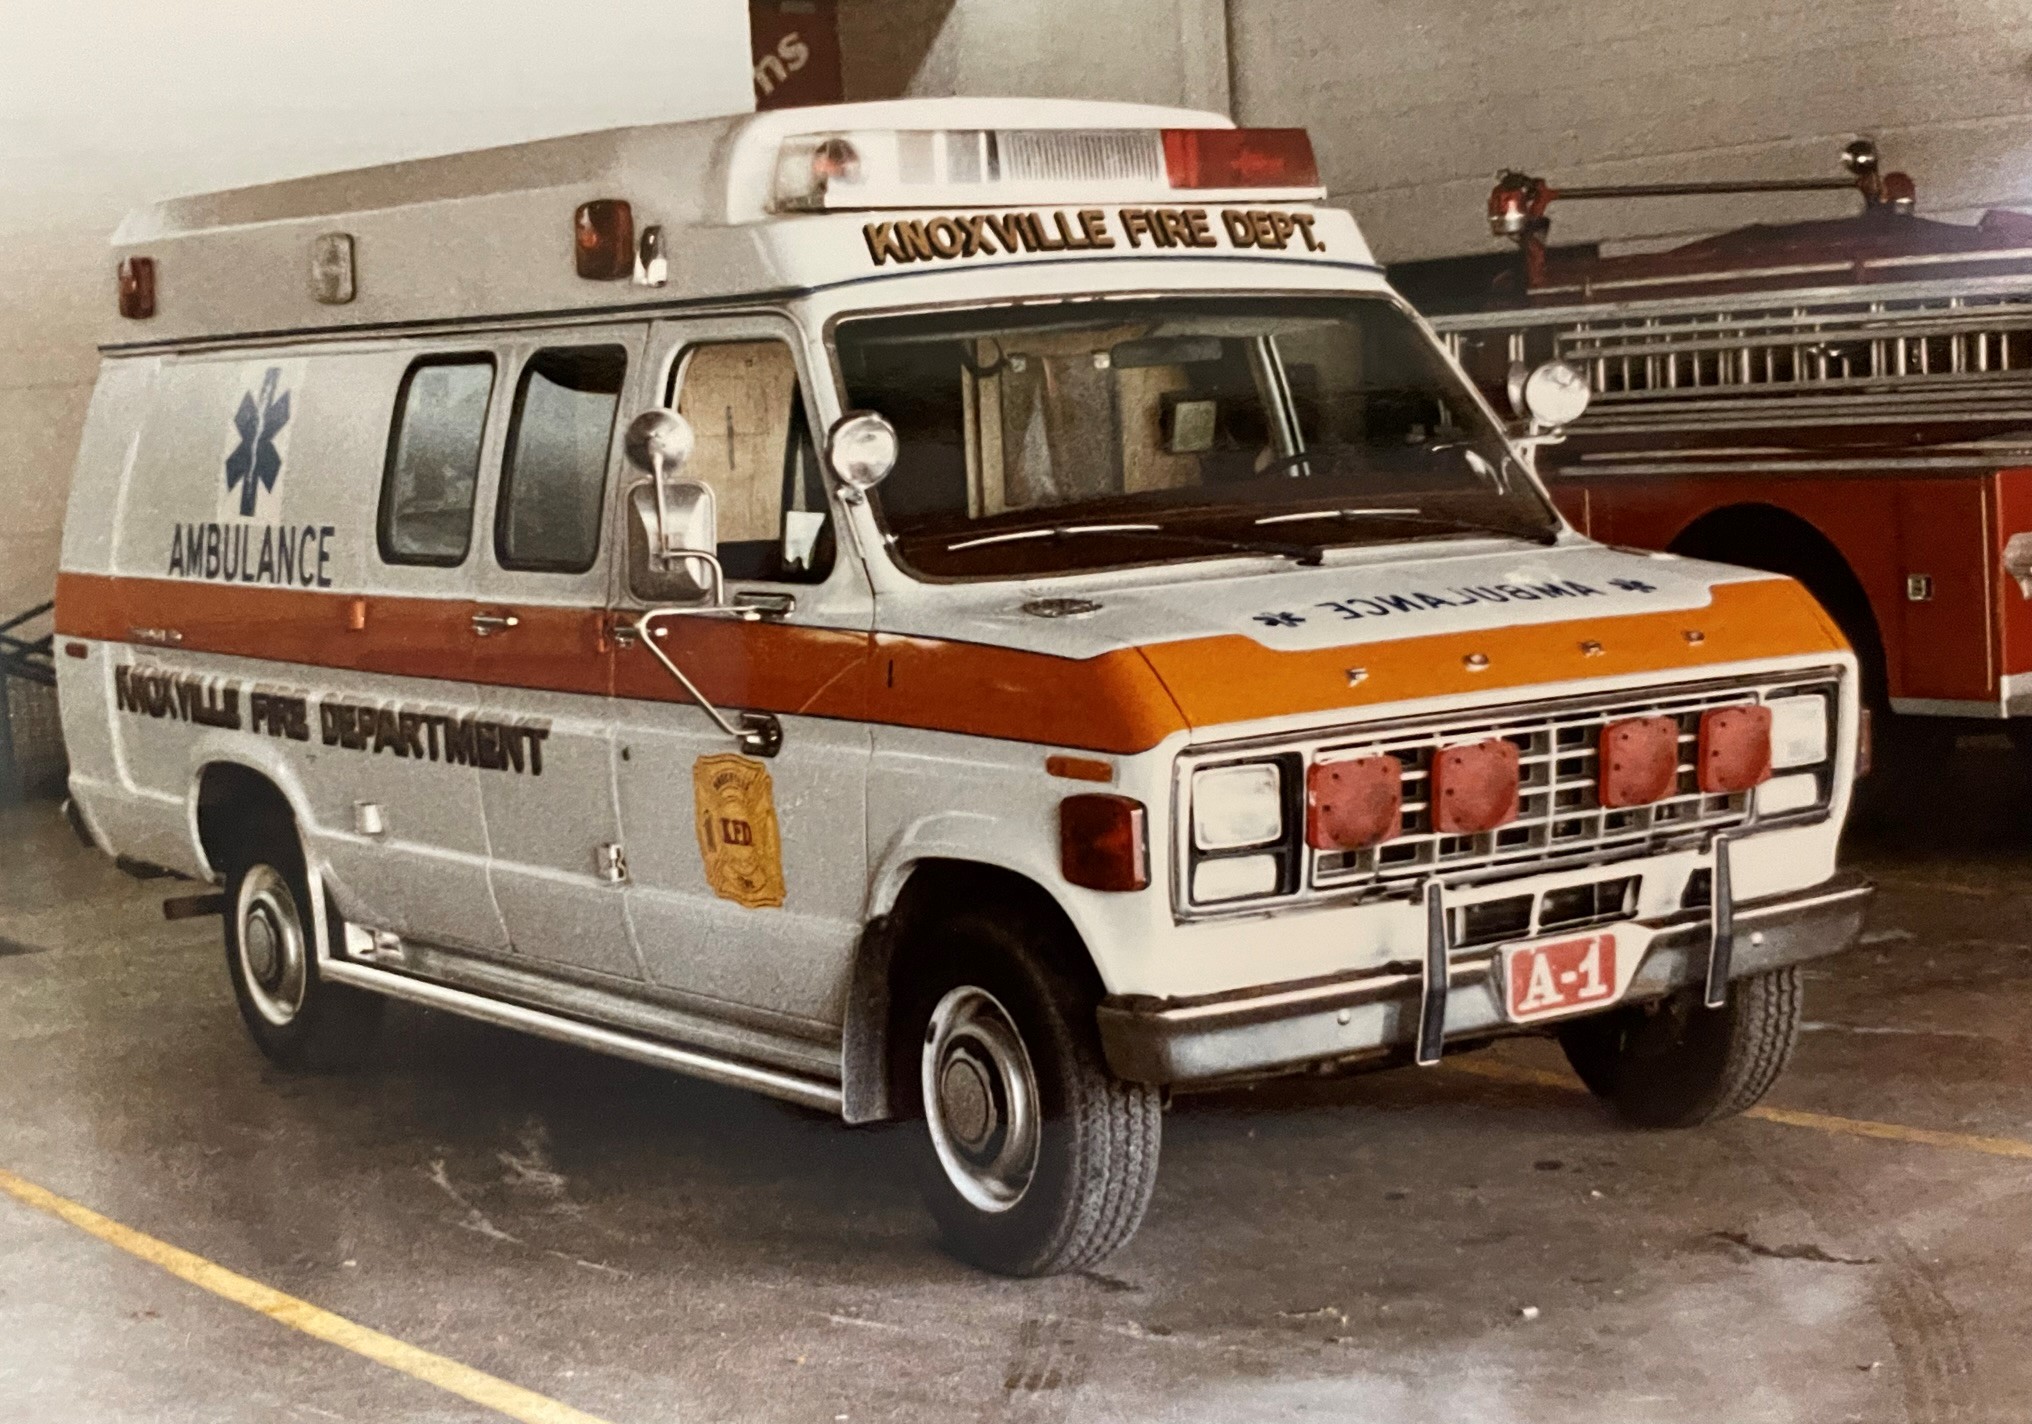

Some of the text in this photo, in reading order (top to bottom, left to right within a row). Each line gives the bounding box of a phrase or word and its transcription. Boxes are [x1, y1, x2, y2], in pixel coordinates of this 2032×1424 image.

[863, 208, 1327, 266] KNOXVILLE FIRE DEPT.
[168, 522, 335, 588] AMBULANCE
[116, 665, 549, 776] KNOXVILLE FIRE DEPARTMENT
[1518, 938, 1608, 1011] A-1
